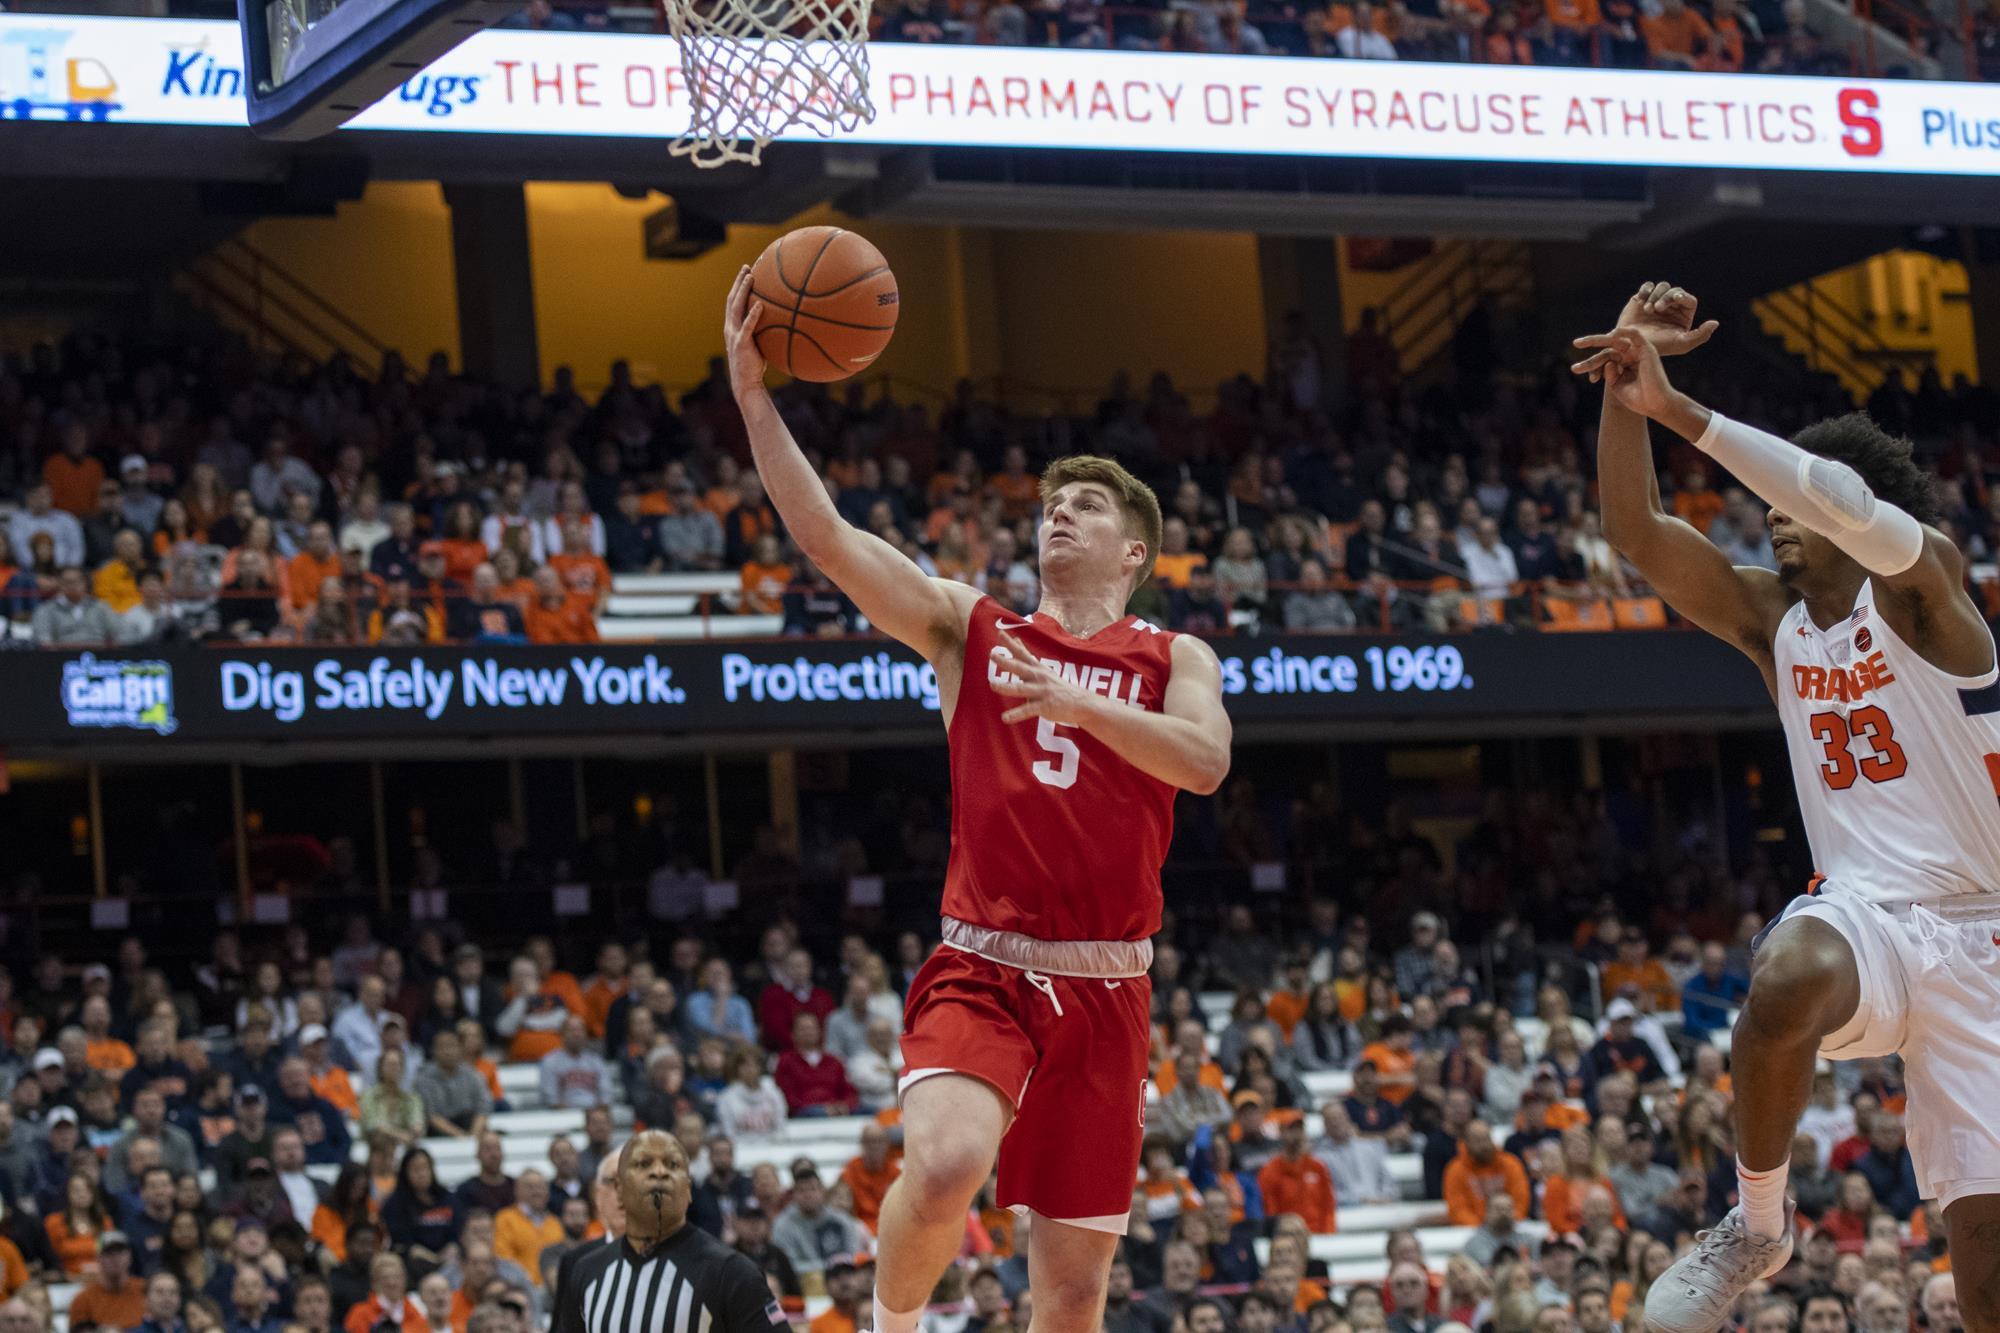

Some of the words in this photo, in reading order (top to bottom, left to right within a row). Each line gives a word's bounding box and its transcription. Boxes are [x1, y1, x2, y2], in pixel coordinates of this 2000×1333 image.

[161, 48, 247, 97] Kin
[399, 74, 481, 116] ugs
[494, 60, 602, 106] THE
[888, 73, 1184, 122] PHARMACY
[1203, 83, 1263, 126] OF
[1284, 86, 1545, 135] SYRACUSE
[1564, 97, 1818, 143] ATHLETICS
[1836, 86, 1884, 158] S
[1921, 107, 2000, 150] Plus
[220, 660, 305, 722] Dig
[313, 656, 454, 721] Safely
[460, 657, 568, 708] New
[570, 653, 687, 705] York.
[721, 651, 940, 710] Protecting
[987, 645, 1146, 711] CNELL
[1251, 646, 1358, 694] since
[1364, 645, 1474, 692] 1969.
[1791, 650, 1896, 704] ORANGE
[1032, 715, 1081, 790] 5
[1810, 704, 1908, 790] 33
